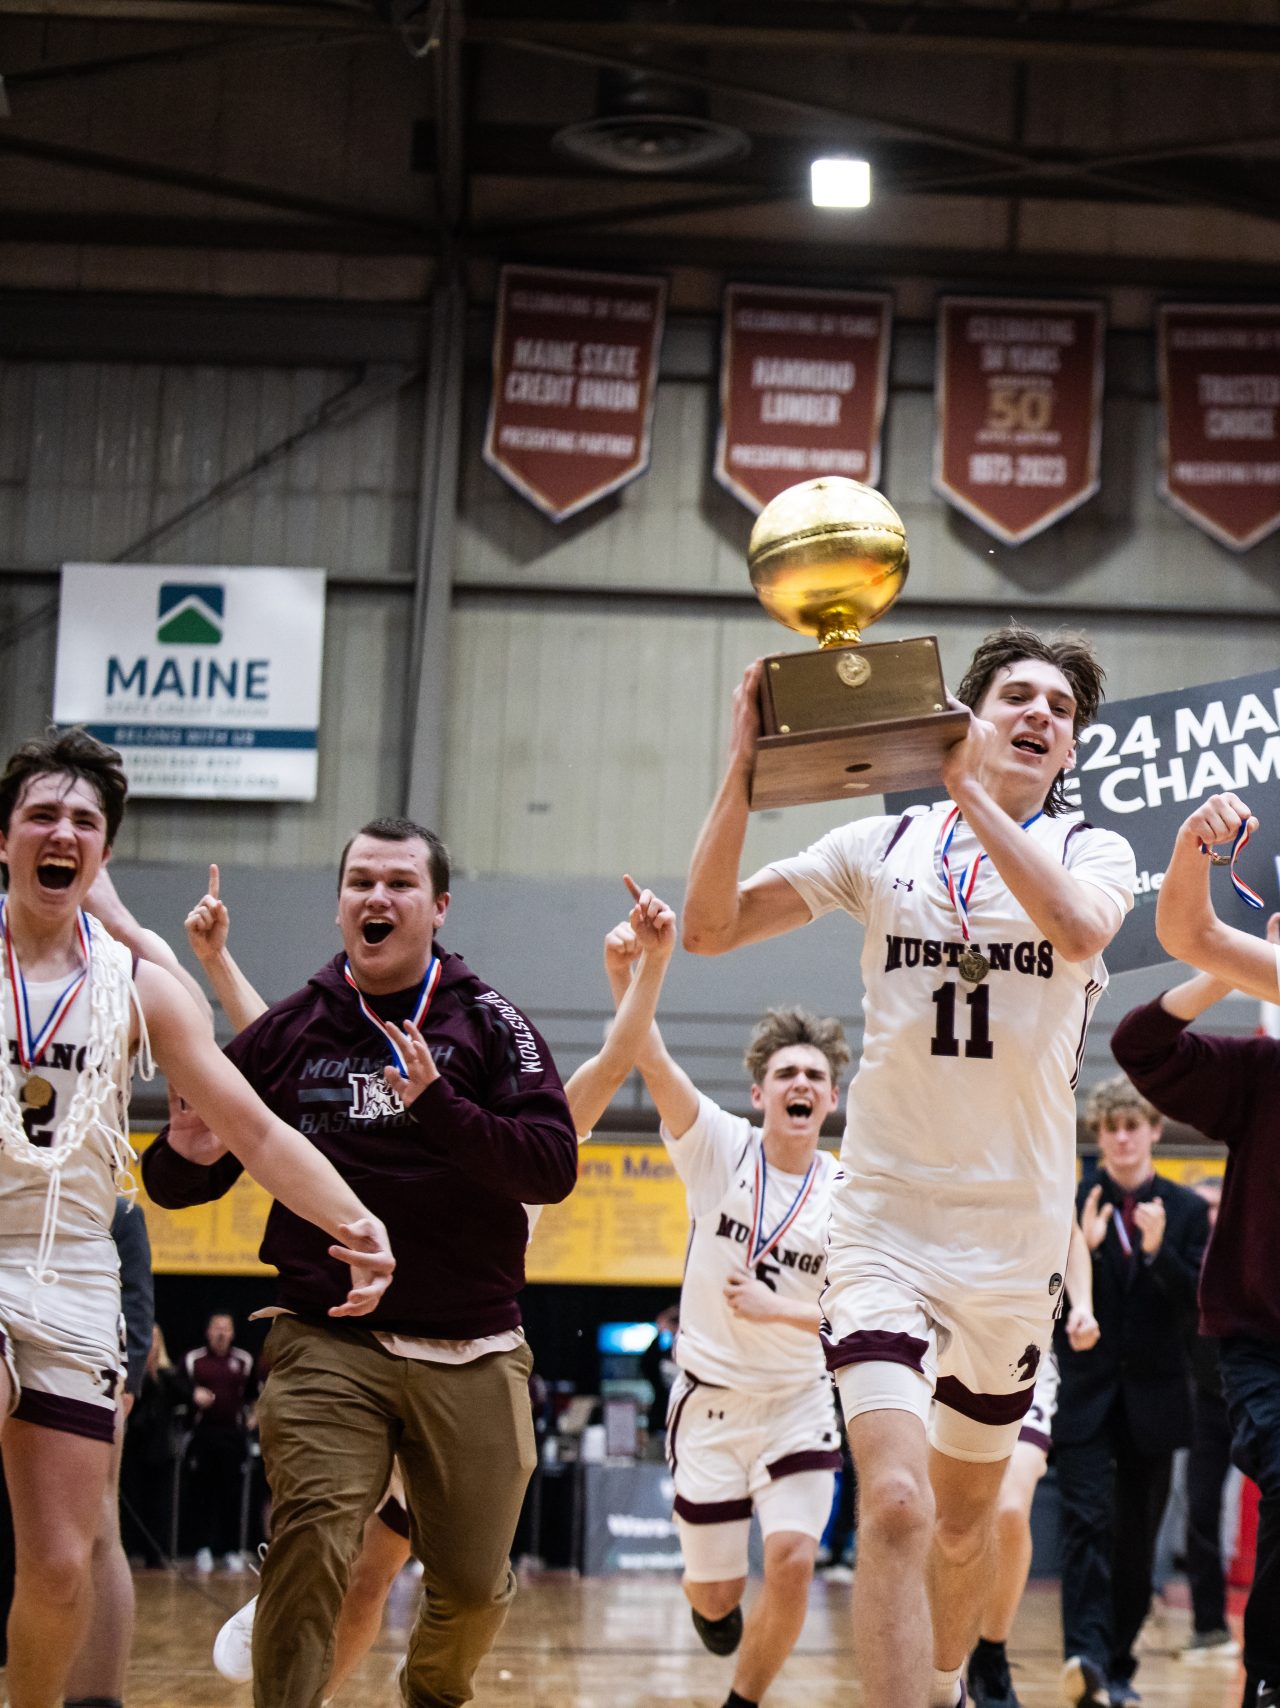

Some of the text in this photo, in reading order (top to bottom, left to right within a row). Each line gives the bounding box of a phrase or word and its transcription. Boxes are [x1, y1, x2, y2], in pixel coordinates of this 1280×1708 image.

[512, 338, 640, 379] MAINE STATE
[505, 371, 640, 412] CREDIT UNION
[760, 392, 842, 426] LUMBER
[986, 388, 1053, 432] 50
[105, 656, 270, 701] MAINE
[185, 729, 228, 747] WITH
[1079, 714, 1161, 771] 24
[475, 990, 545, 1073] BERGSTROM
[930, 981, 994, 1059] 11
[715, 1212, 825, 1276] MUNGS
